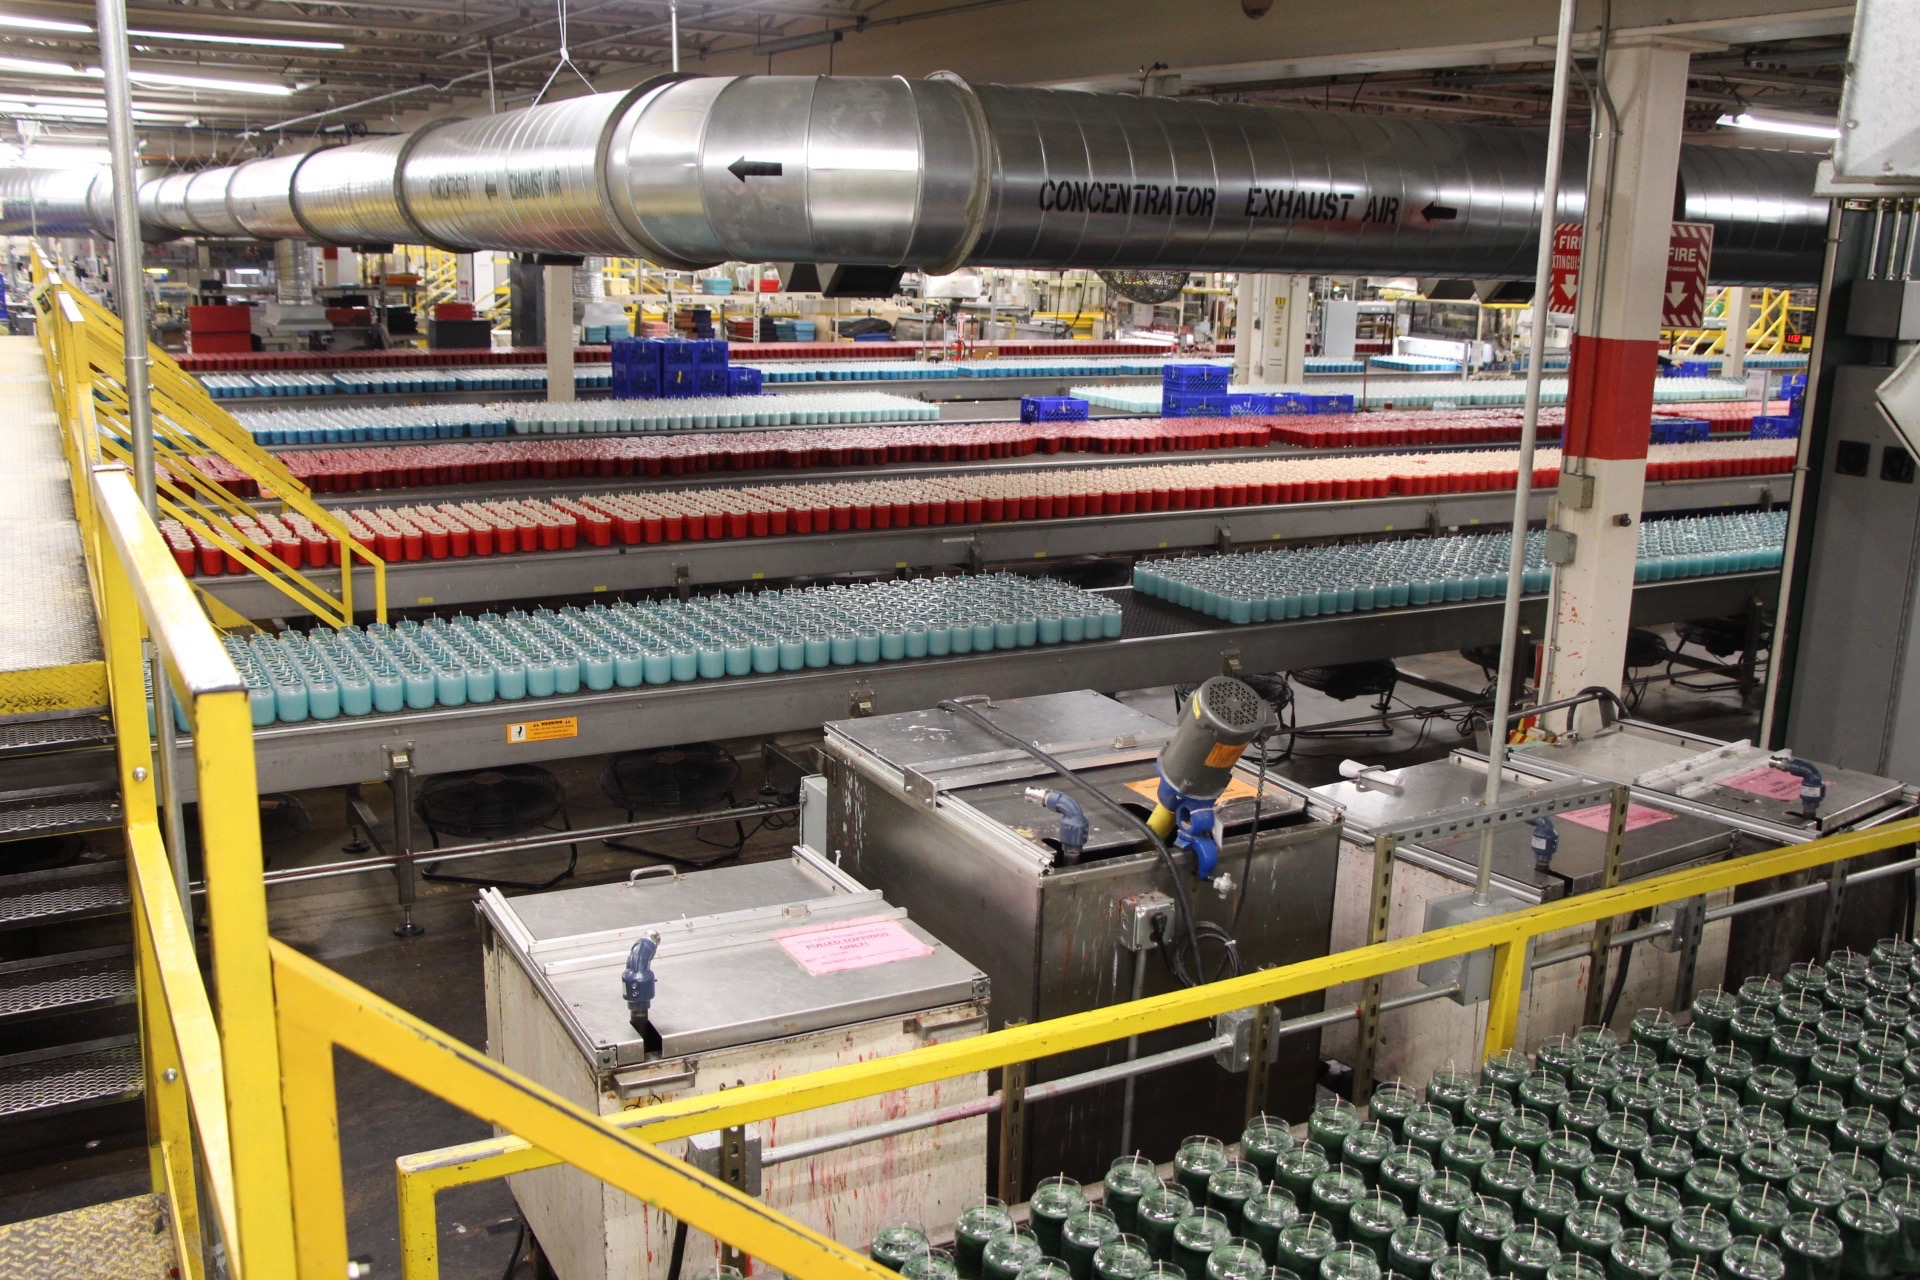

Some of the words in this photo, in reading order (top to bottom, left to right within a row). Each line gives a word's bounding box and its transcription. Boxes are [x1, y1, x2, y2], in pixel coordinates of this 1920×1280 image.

[1038, 179, 1217, 217] CONCENTRATOR
[1244, 187, 1355, 222] EXHAUST
[1361, 195, 1400, 224] AIR
[1669, 247, 1697, 262] FIRE
[806, 940, 841, 950] PULLED
[843, 931, 890, 944] TOPPINGS
[839, 941, 869, 951] ONLY!
